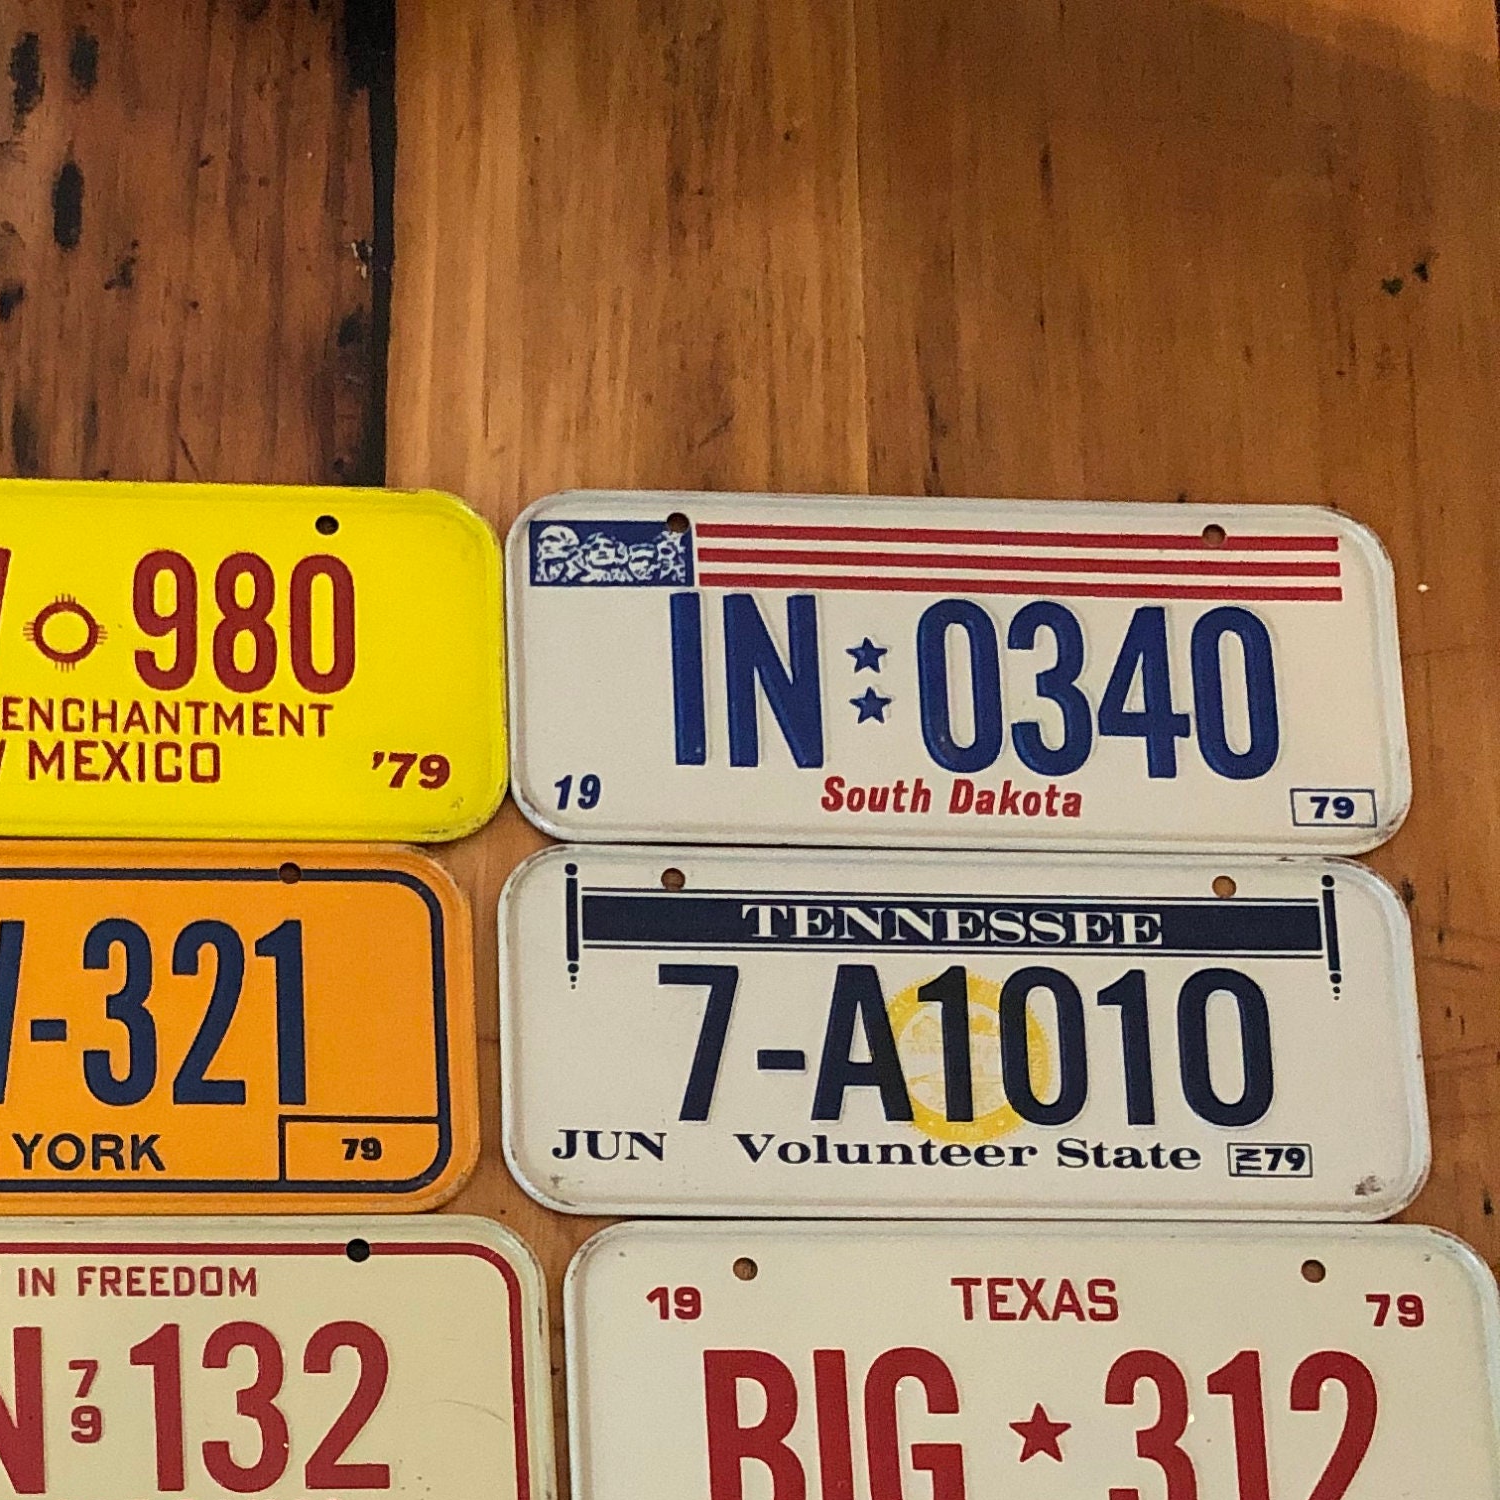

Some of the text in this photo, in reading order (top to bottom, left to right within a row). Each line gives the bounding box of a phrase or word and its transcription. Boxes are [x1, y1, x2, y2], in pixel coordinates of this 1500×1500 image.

[133, 549, 355, 694] 980
[670, 591, 1280, 780] IN 0340
[2, 696, 333, 737] ENCHANTMENT
[29, 739, 220, 783] MEXICO
[372, 751, 450, 789] '79
[555, 774, 600, 810] 19
[821, 776, 1081, 817] South Dakota
[1309, 796, 1355, 821] 79
[742, 904, 1162, 946] TENNESSEE
[659, 964, 1274, 1127] 7-A1010
[20, 1133, 165, 1172] YORK
[342, 1137, 382, 1160] 79
[552, 1130, 666, 1161] JUN
[733, 1134, 1200, 1169] Volunteer State
[1265, 1147, 1306, 1171] 79
[18, 1268, 55, 1296] IN
[78, 1266, 256, 1297] FREEDOM
[951, 1278, 1118, 1321] TEXAS
[646, 1287, 701, 1320] 19
[1366, 1294, 1424, 1327] 79
[130, 1321, 390, 1493] 132
